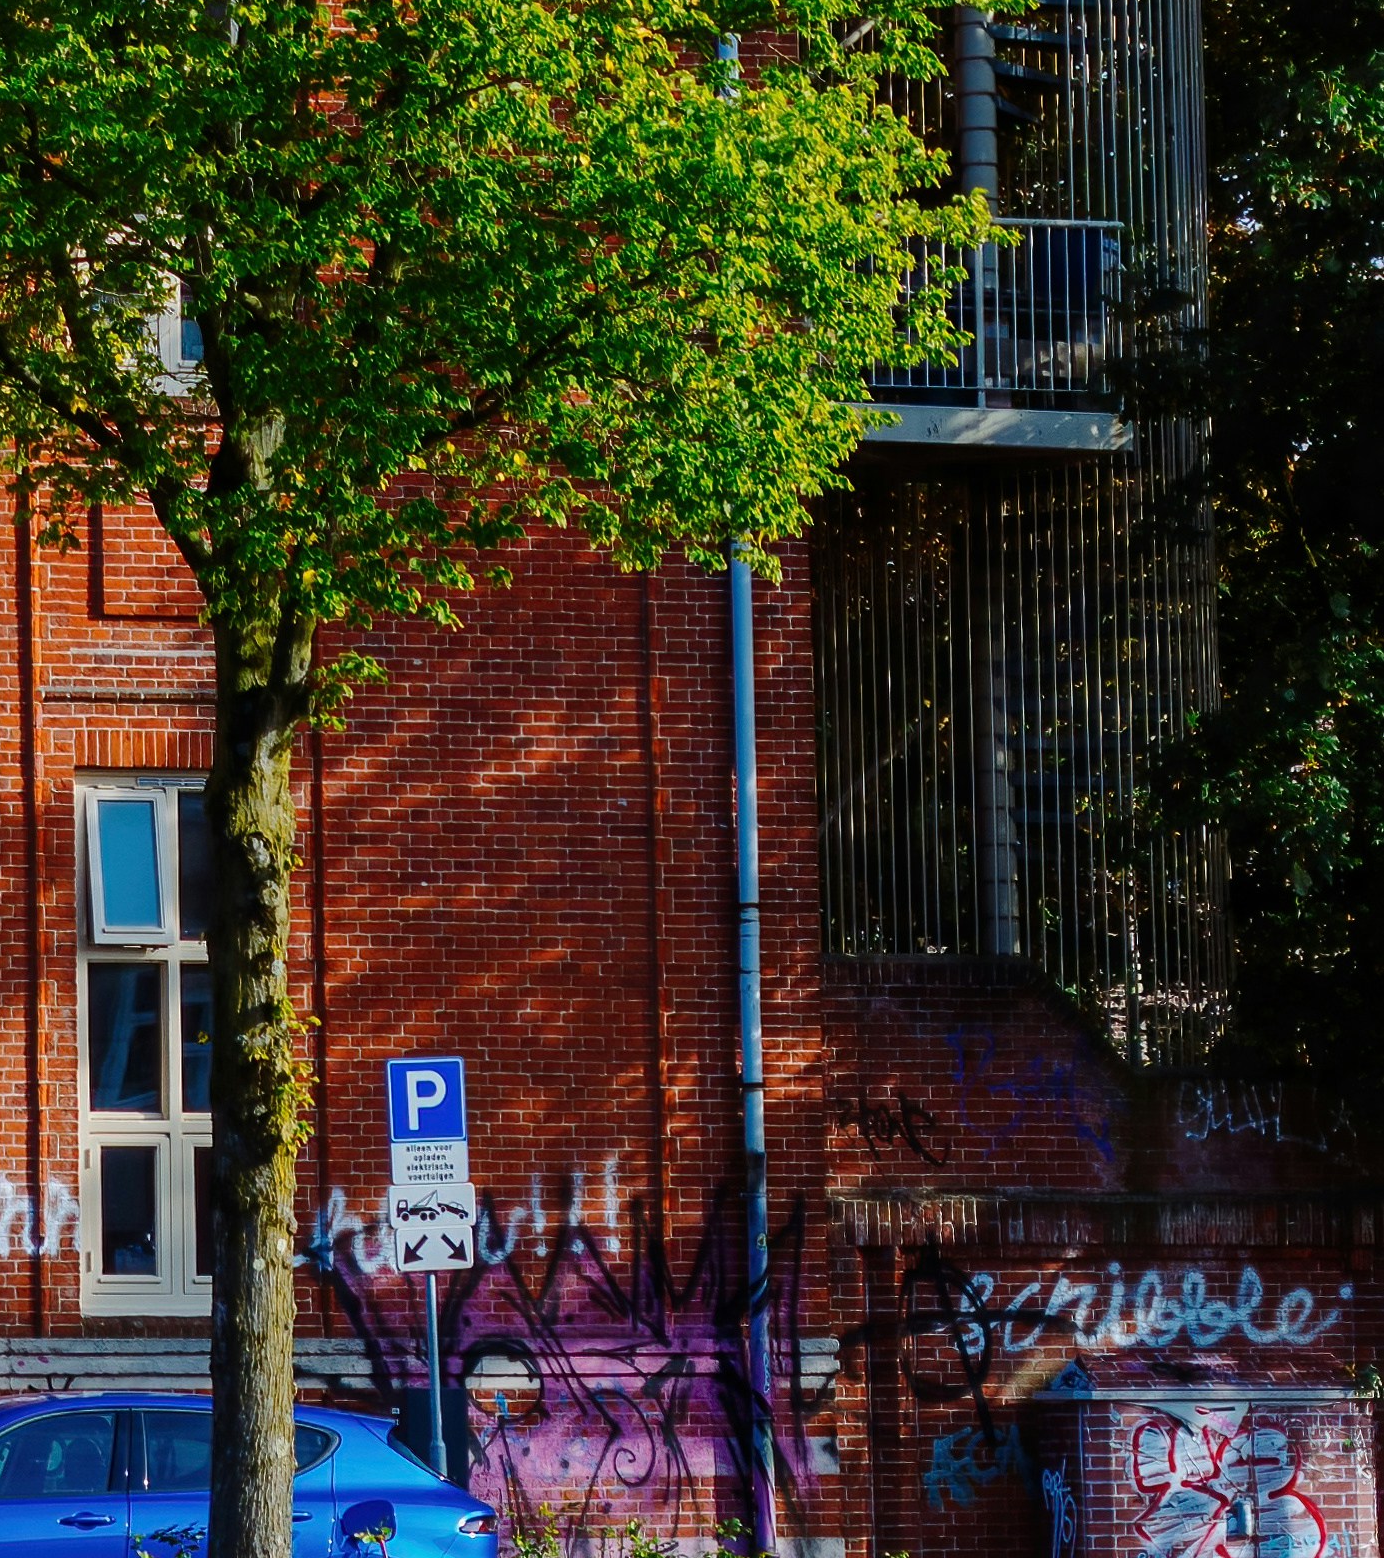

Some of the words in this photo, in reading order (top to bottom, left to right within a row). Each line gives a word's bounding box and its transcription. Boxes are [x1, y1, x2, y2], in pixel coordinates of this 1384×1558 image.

[406, 1070, 446, 1131] P
[413, 1153, 447, 1161] opladen
[406, 1162, 454, 1171] elektrische
[408, 1172, 454, 1181] voertuigen
